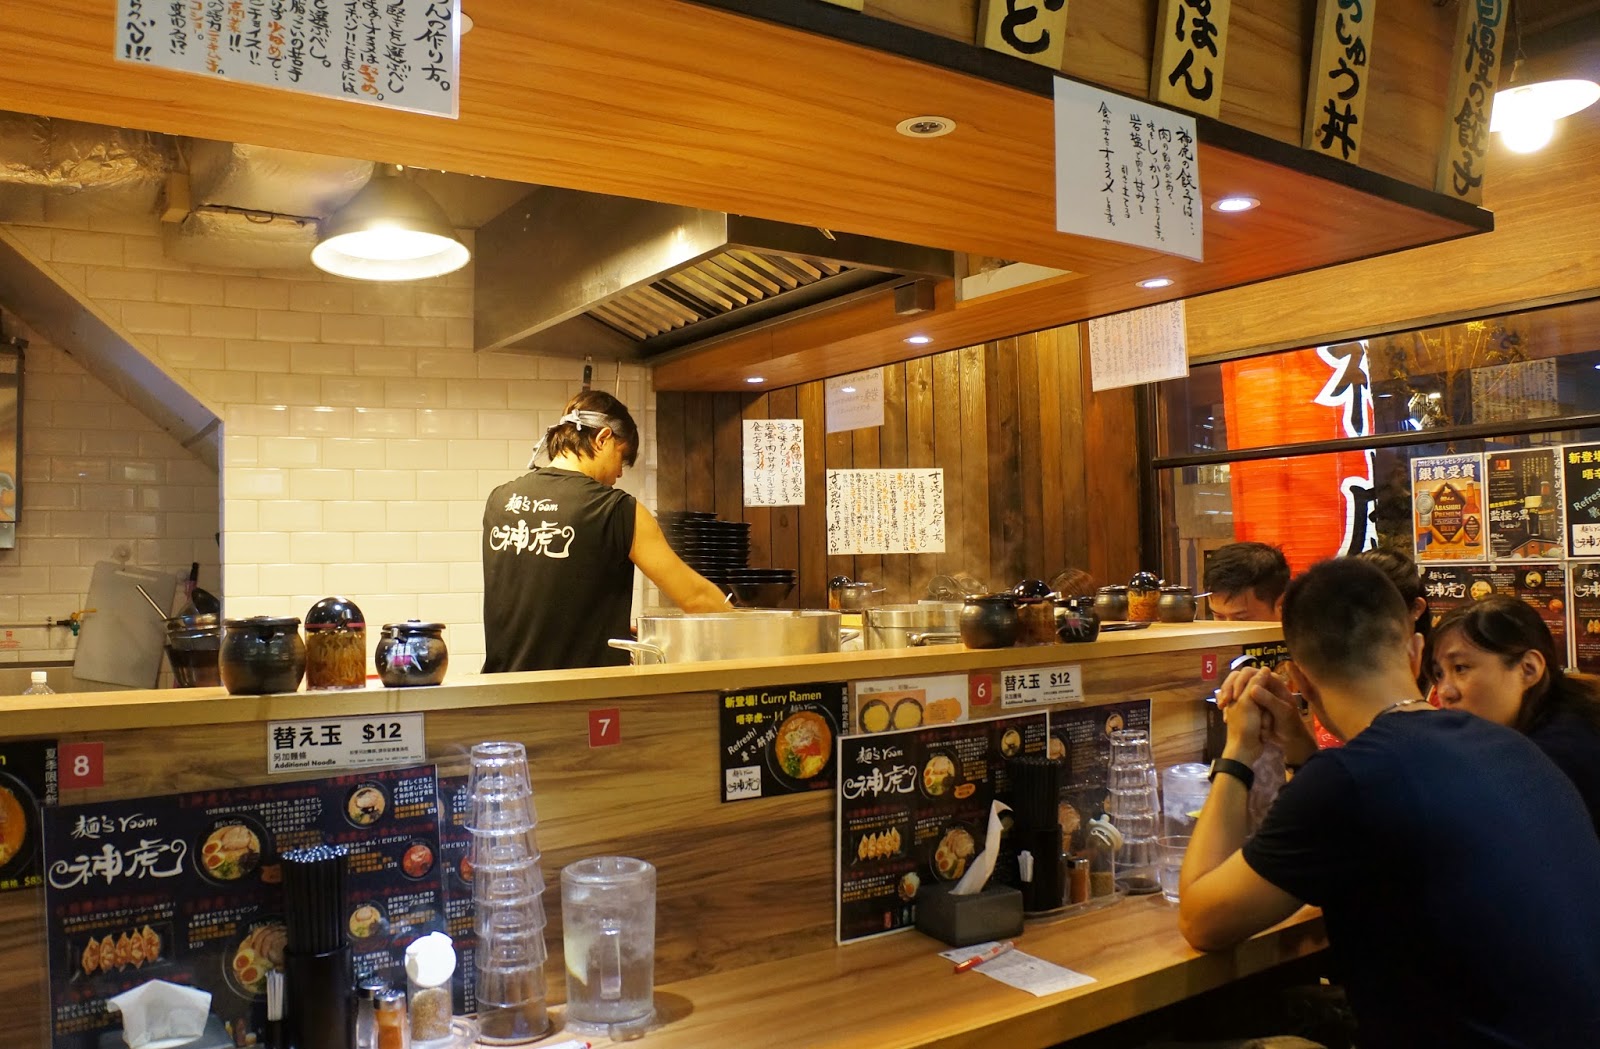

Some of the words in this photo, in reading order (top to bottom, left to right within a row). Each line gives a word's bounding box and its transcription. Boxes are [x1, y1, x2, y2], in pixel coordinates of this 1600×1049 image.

[1418, 464, 1476, 481] 銀賞受賞
[489, 519, 575, 559] 神虎
[1425, 582, 1466, 599] 神虎
[1574, 581, 1600, 598] 神
[1205, 660, 1213, 674] 5
[977, 682, 987, 698] 6
[1004, 674, 1041, 691] 替え玉
[1050, 672, 1071, 685] $12
[760, 692, 788, 705] Curry
[789, 690, 823, 703] Ramen
[273, 724, 342, 751] 替え玉
[362, 722, 402, 743] $12
[597, 718, 611, 737] 7
[73, 755, 90, 777] 8
[274, 760, 310, 769] Additional
[312, 759, 337, 767] Noodle
[842, 764, 918, 800] 神虎
[49, 839, 187, 889] 神虎
